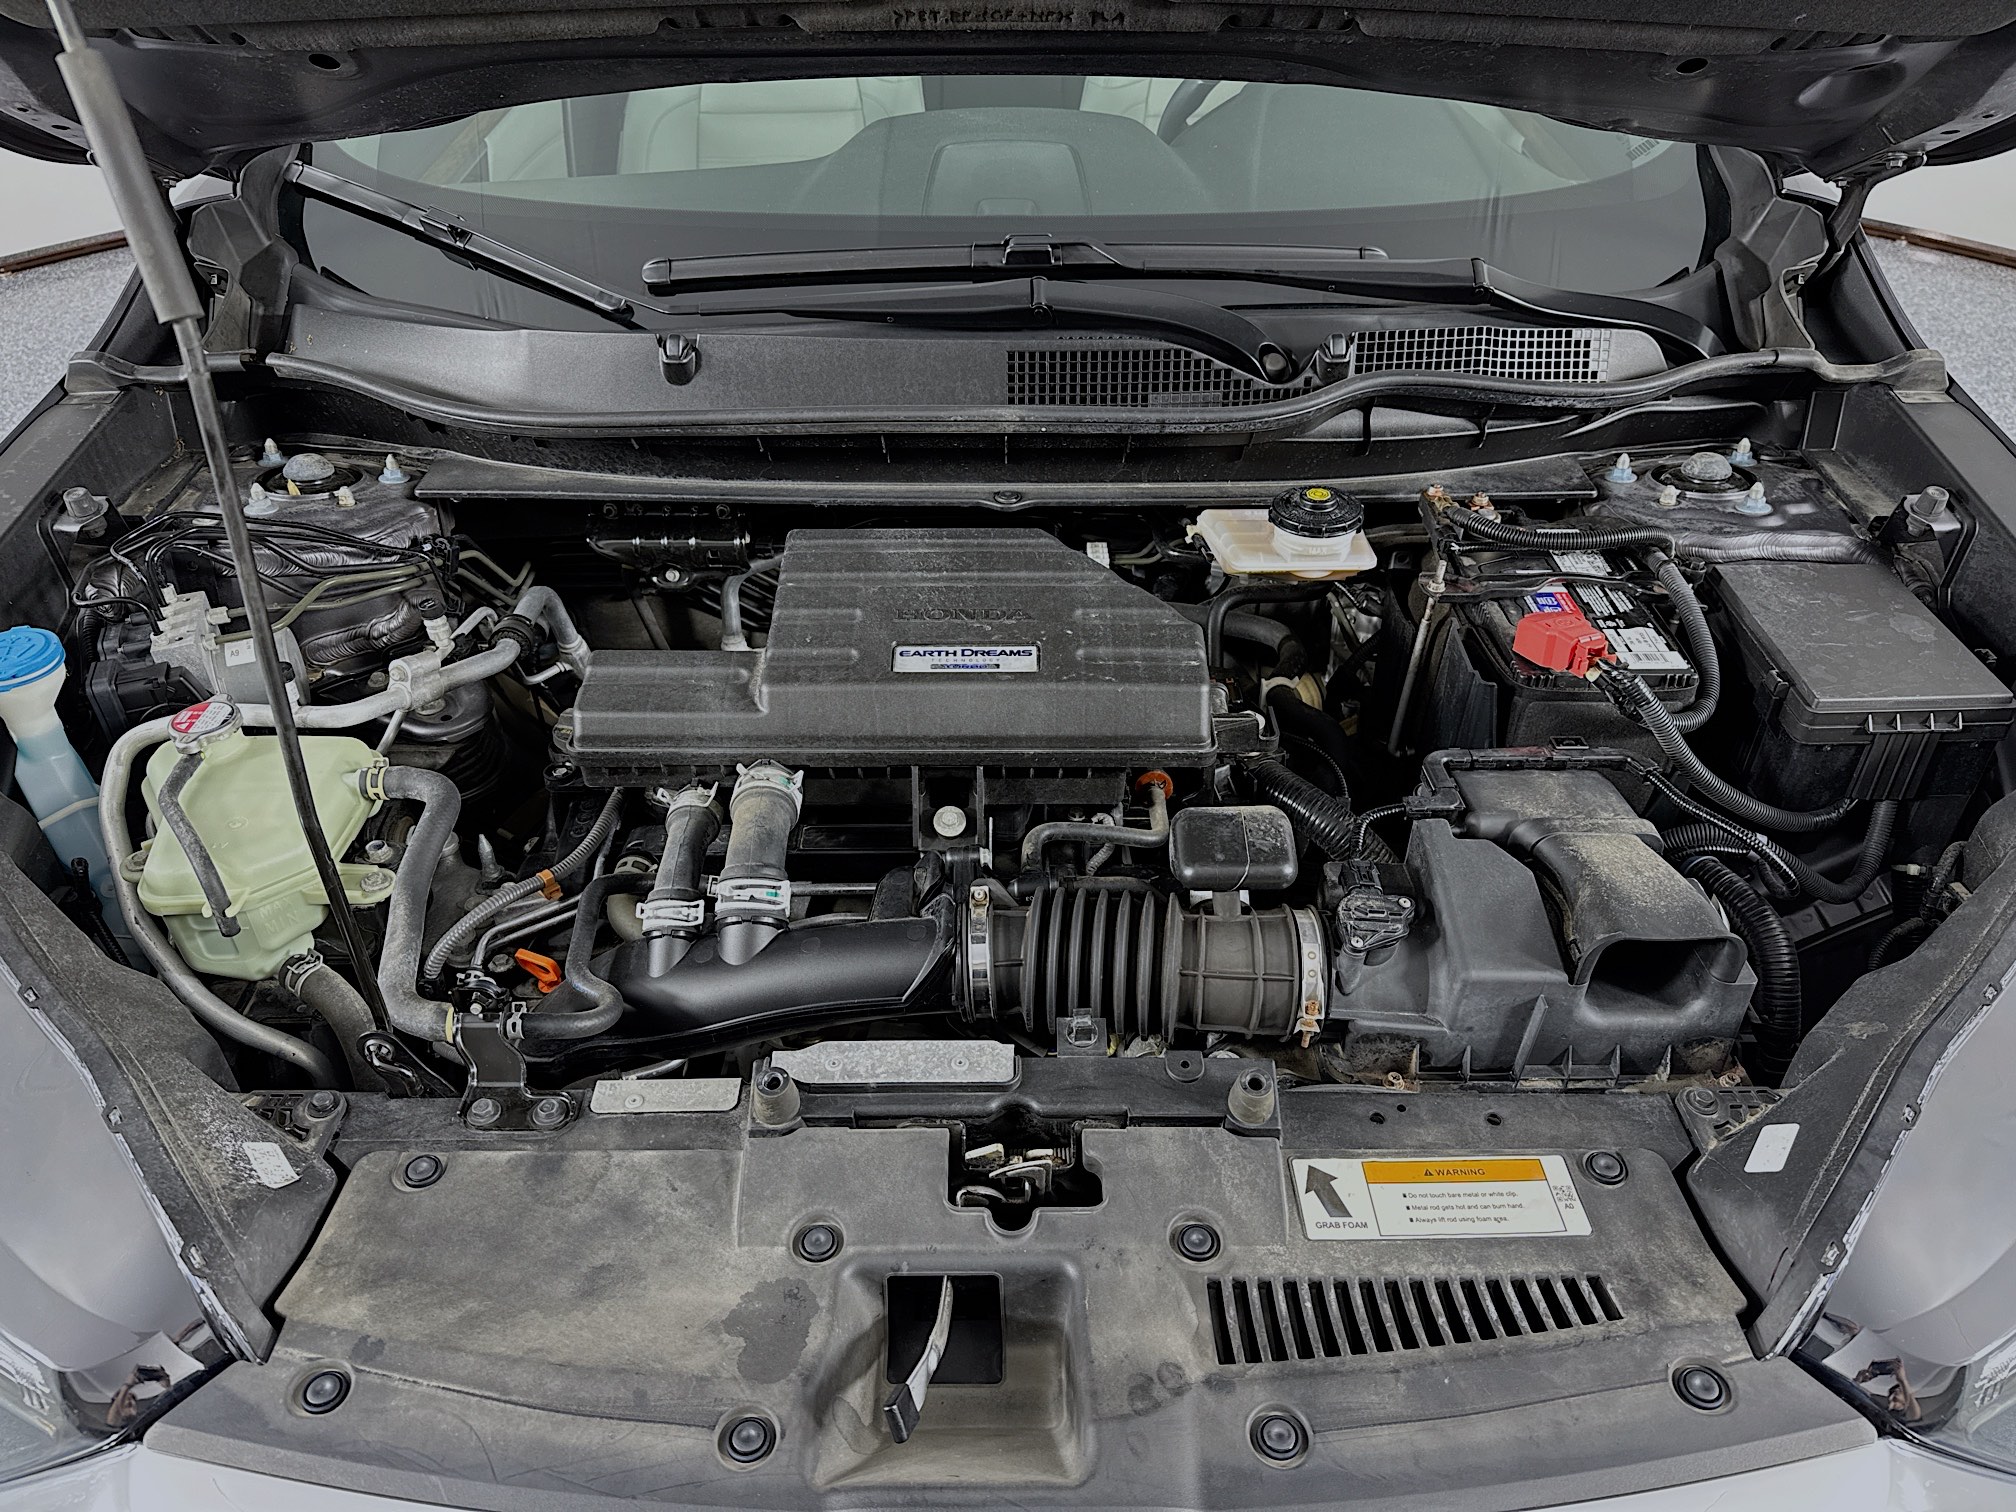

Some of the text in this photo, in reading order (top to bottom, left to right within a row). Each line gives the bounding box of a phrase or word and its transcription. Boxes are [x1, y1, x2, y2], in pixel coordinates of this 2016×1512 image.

[893, 608, 1034, 621] HONDA
[230, 649, 239, 657] A9
[961, 649, 1032, 657] DREAMS
[265, 911, 298, 934] MIN
[1435, 1168, 1485, 1176] WARNING
[1316, 1221, 1368, 1229] GRAB FOAM
